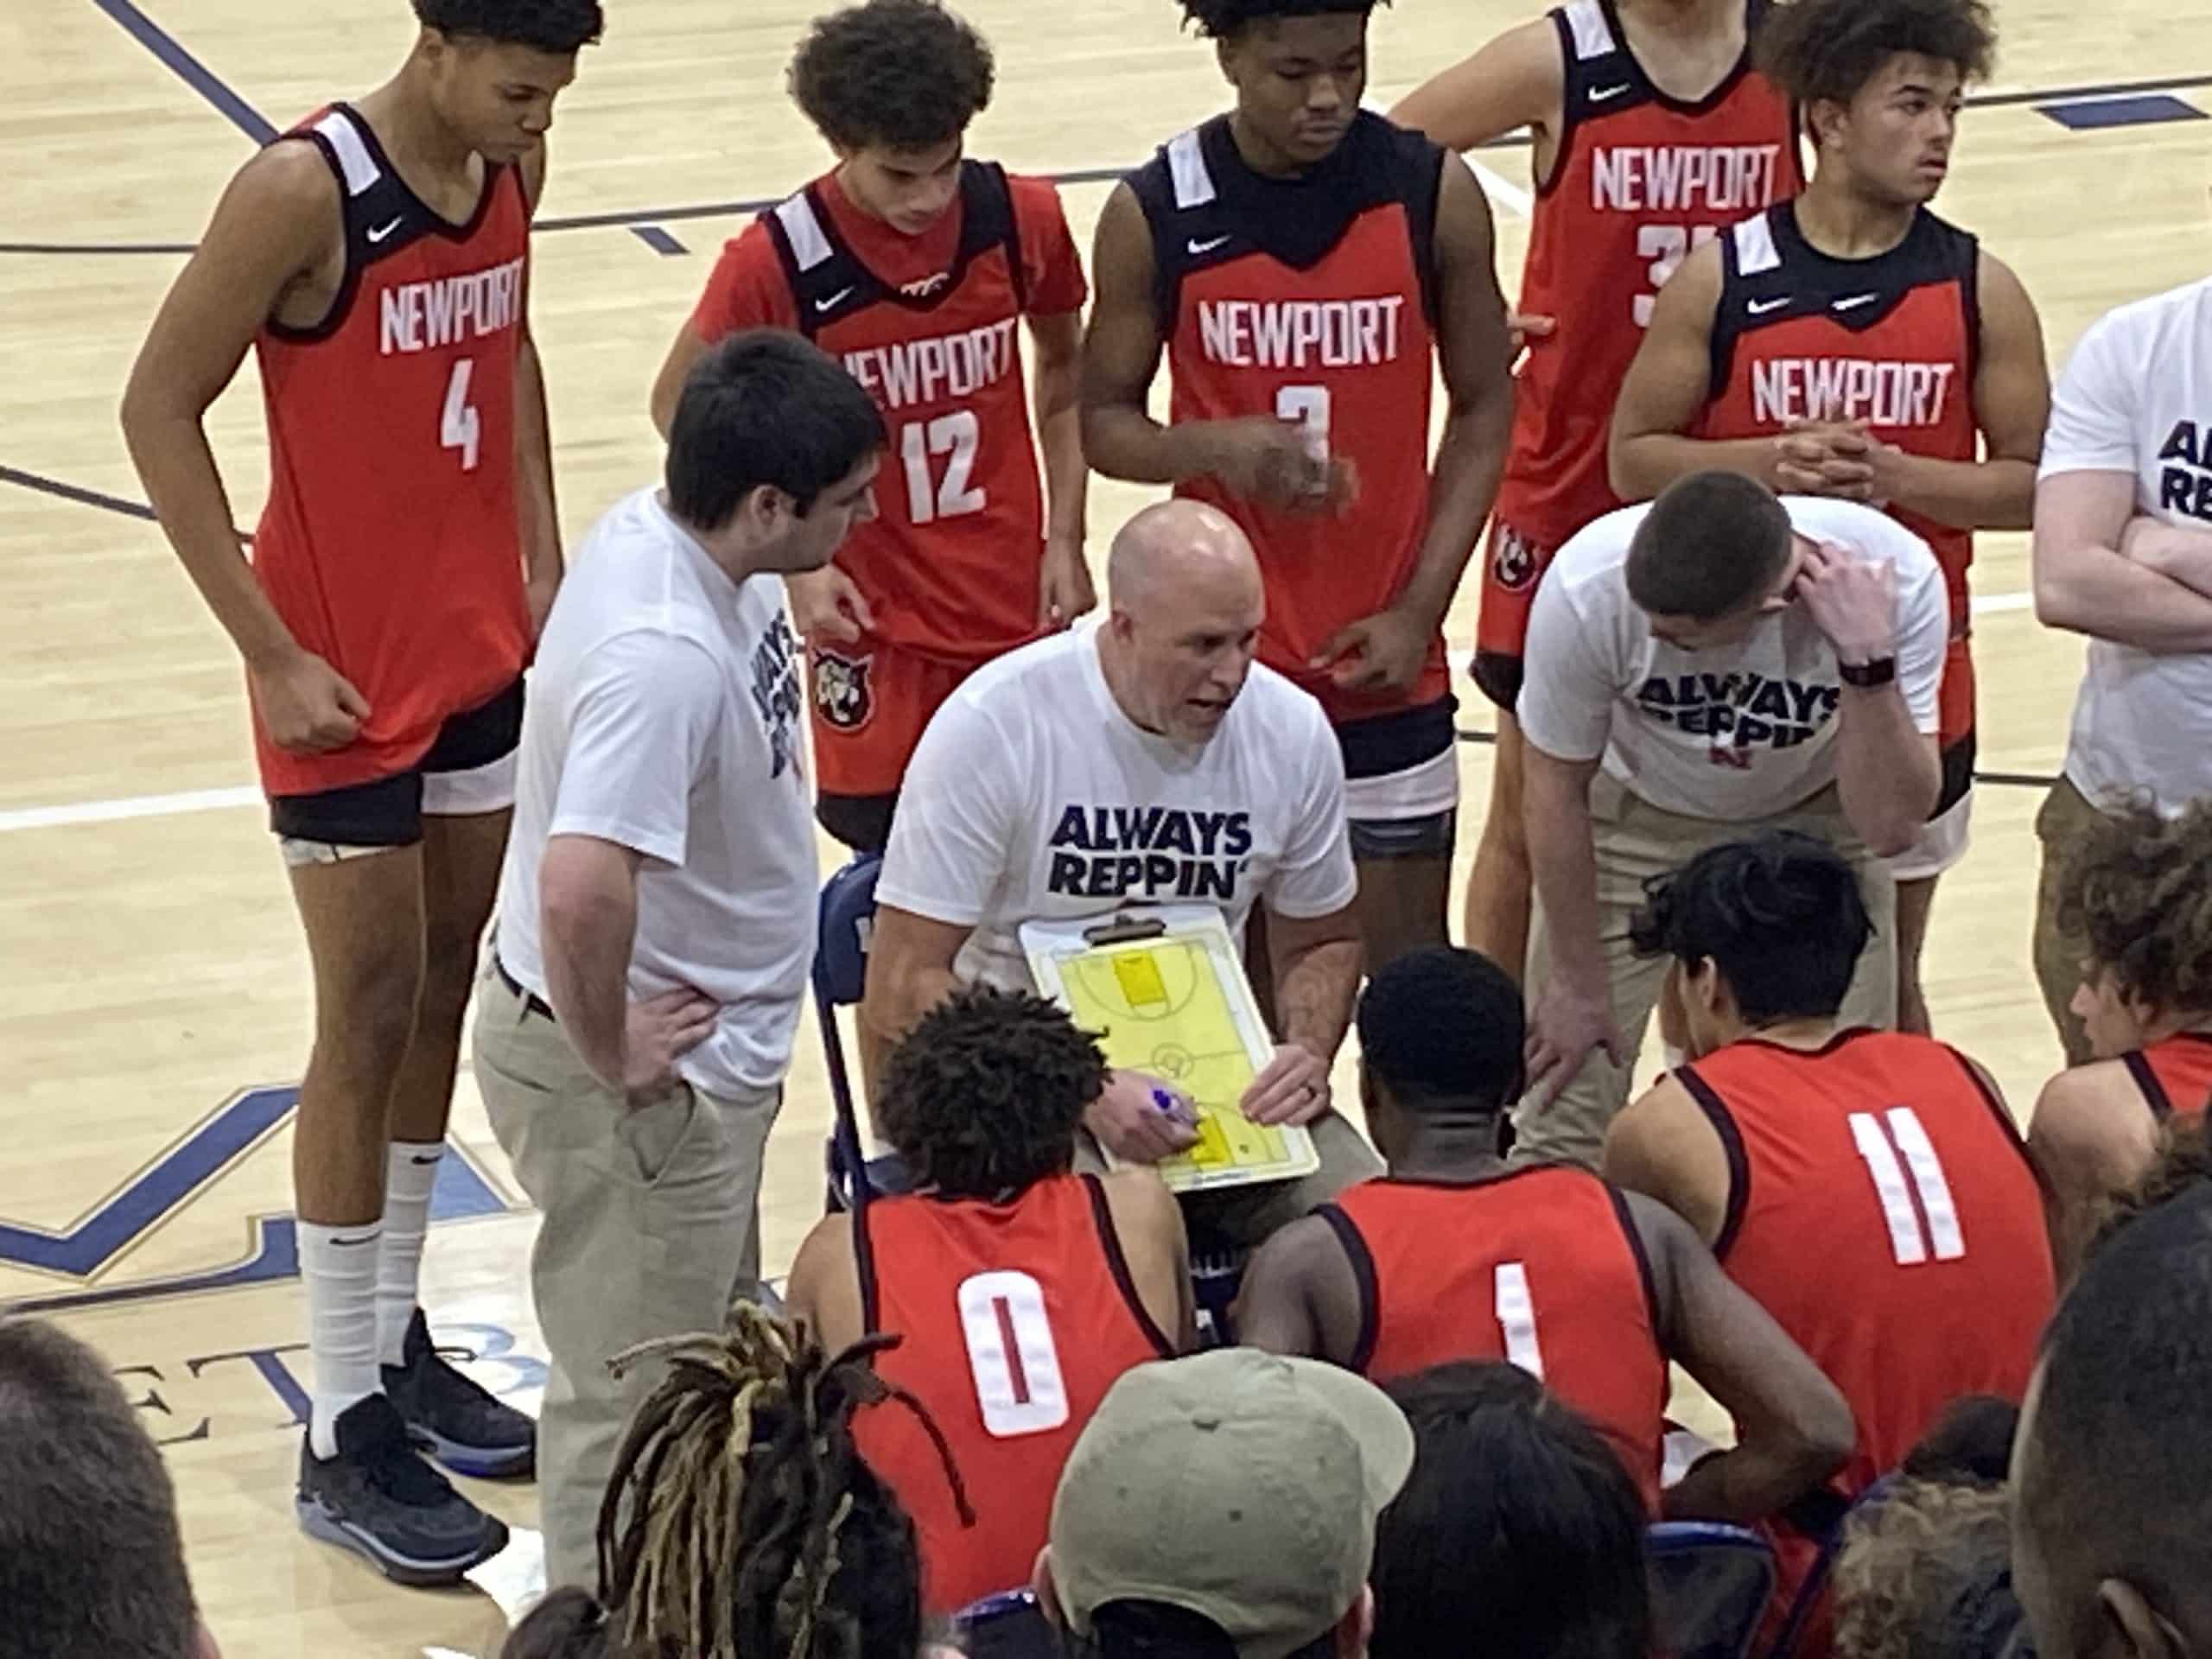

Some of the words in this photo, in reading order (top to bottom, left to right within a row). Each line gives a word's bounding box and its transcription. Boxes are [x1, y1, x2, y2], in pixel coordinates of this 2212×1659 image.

[1592, 144, 1782, 211] NEWPORT
[379, 255, 525, 355] NEWPORT
[1632, 225, 1722, 328] 3
[1198, 295, 1404, 368] NEWPORT
[441, 357, 480, 471] 4
[1753, 359, 1954, 427] NEWPORT
[900, 410, 987, 524] 12
[1637, 671, 1841, 722] ALWAYS
[1049, 804, 1253, 855] ALWAYS
[1848, 1106, 1966, 1265] 11
[957, 1268, 1071, 1437] 0
[1494, 1262, 1545, 1383] 1
